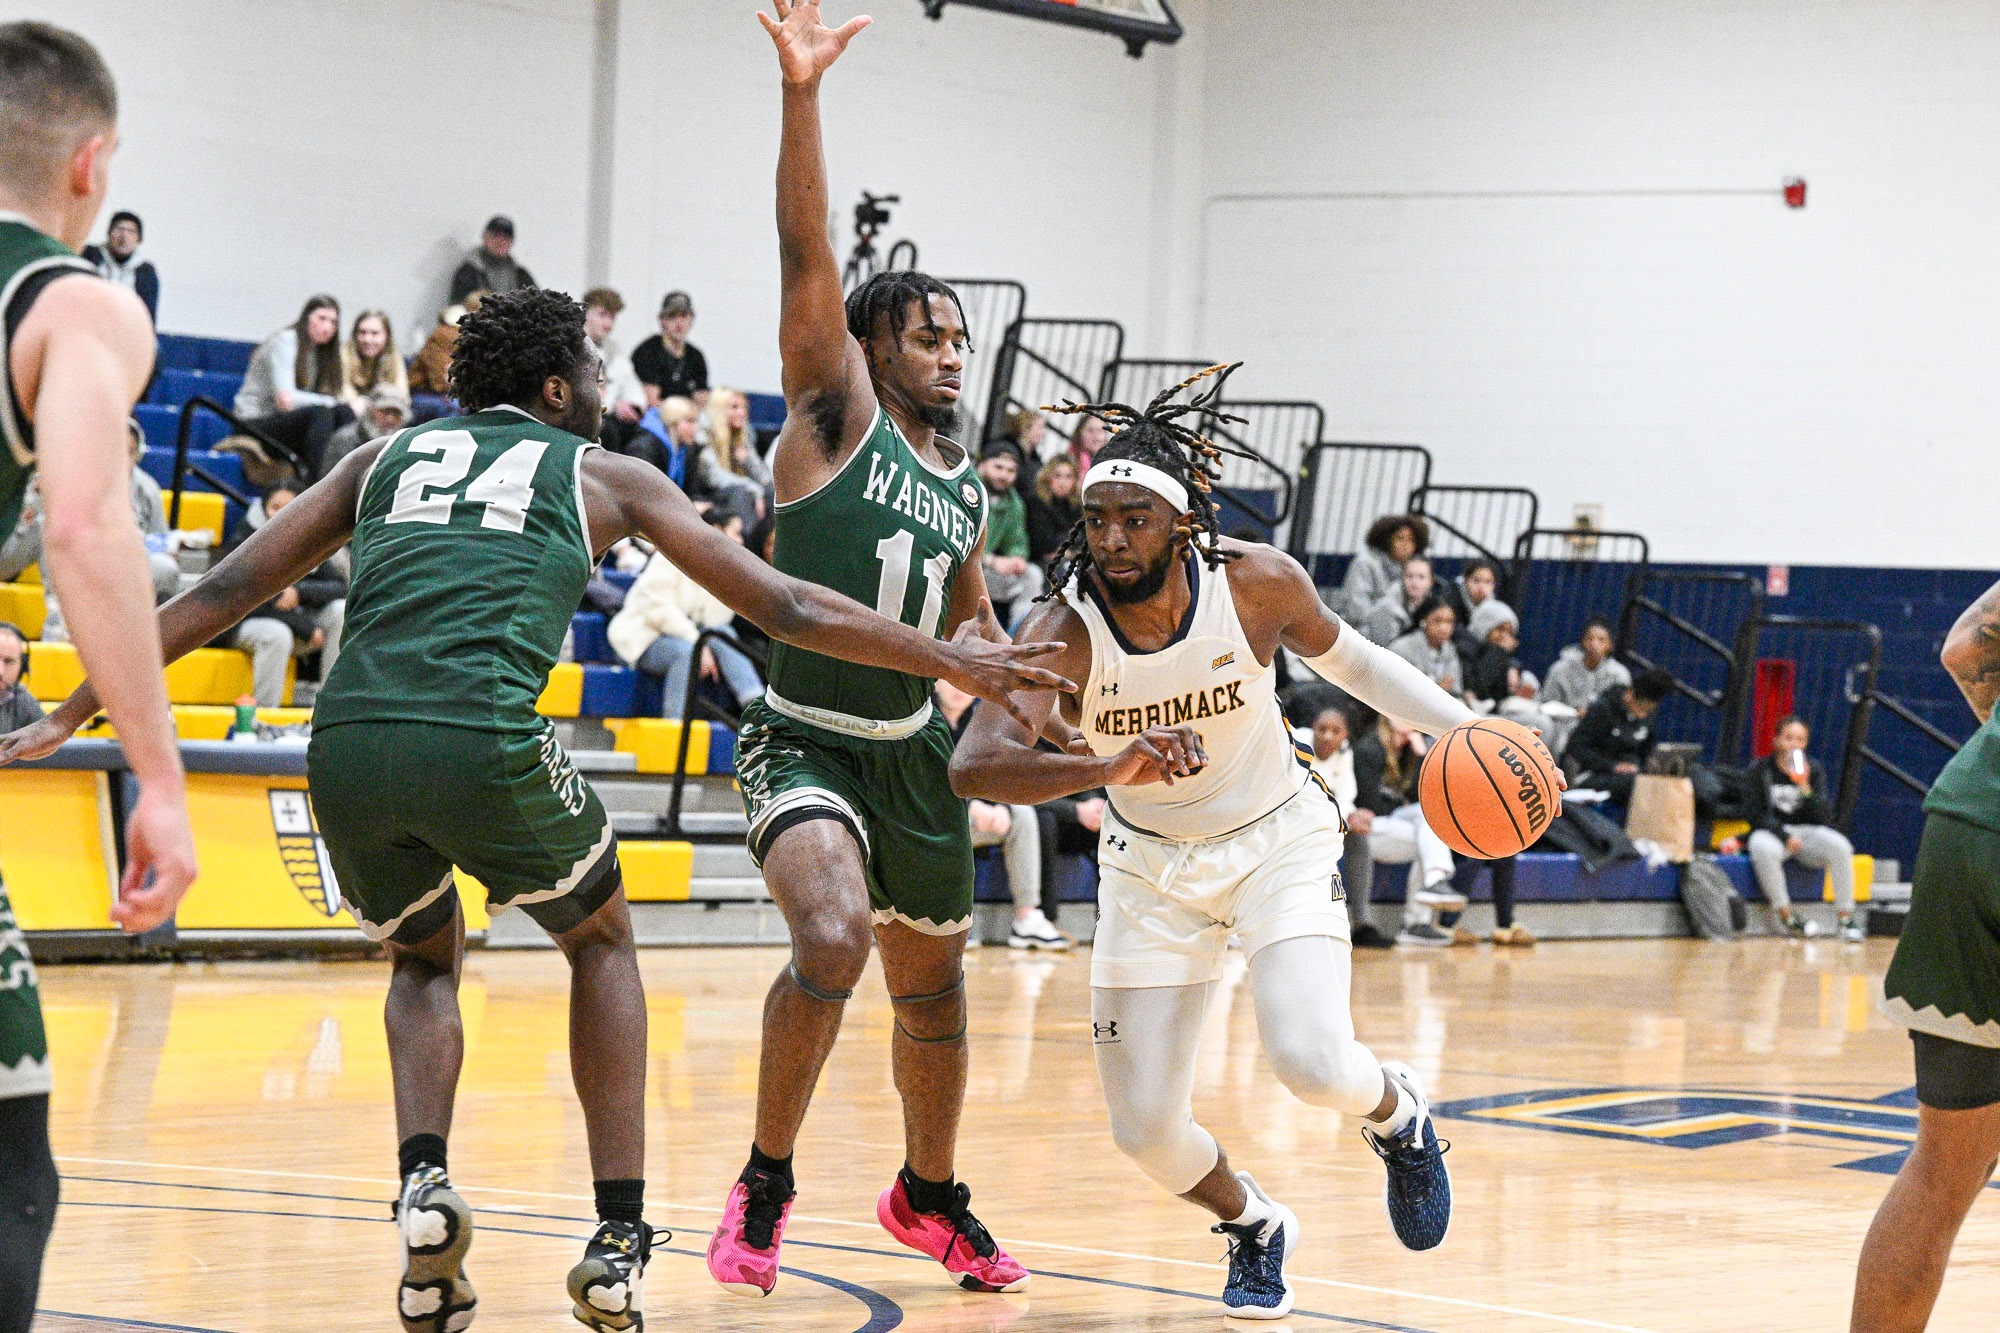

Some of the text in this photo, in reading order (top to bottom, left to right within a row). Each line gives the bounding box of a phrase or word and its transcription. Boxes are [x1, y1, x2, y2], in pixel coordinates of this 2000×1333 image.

[384, 429, 550, 534] 24
[862, 450, 976, 558] WAGNER
[876, 528, 953, 638] 11
[1095, 679, 1246, 736] MERRIMACK
[1498, 744, 1547, 834] Wilson
